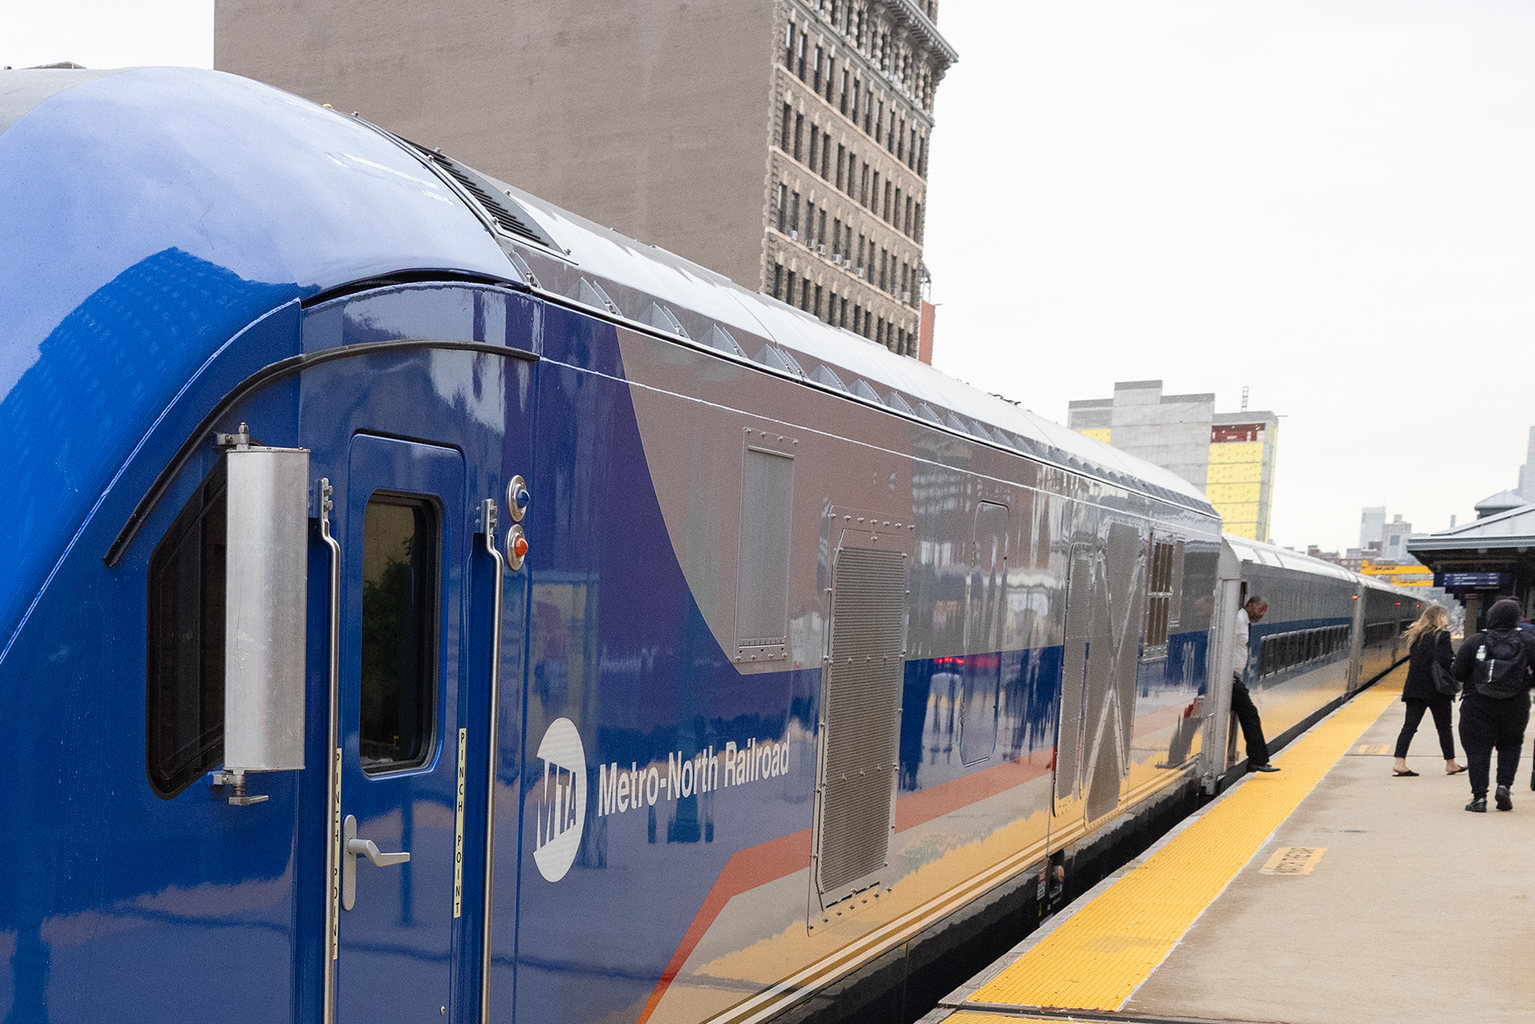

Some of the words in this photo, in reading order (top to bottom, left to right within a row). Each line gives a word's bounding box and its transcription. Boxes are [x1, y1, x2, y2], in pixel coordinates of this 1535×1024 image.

[457, 731, 465, 812] PINCH
[598, 745, 718, 817] Metro-North
[724, 732, 791, 787] Railroad
[455, 834, 463, 915] POINT
